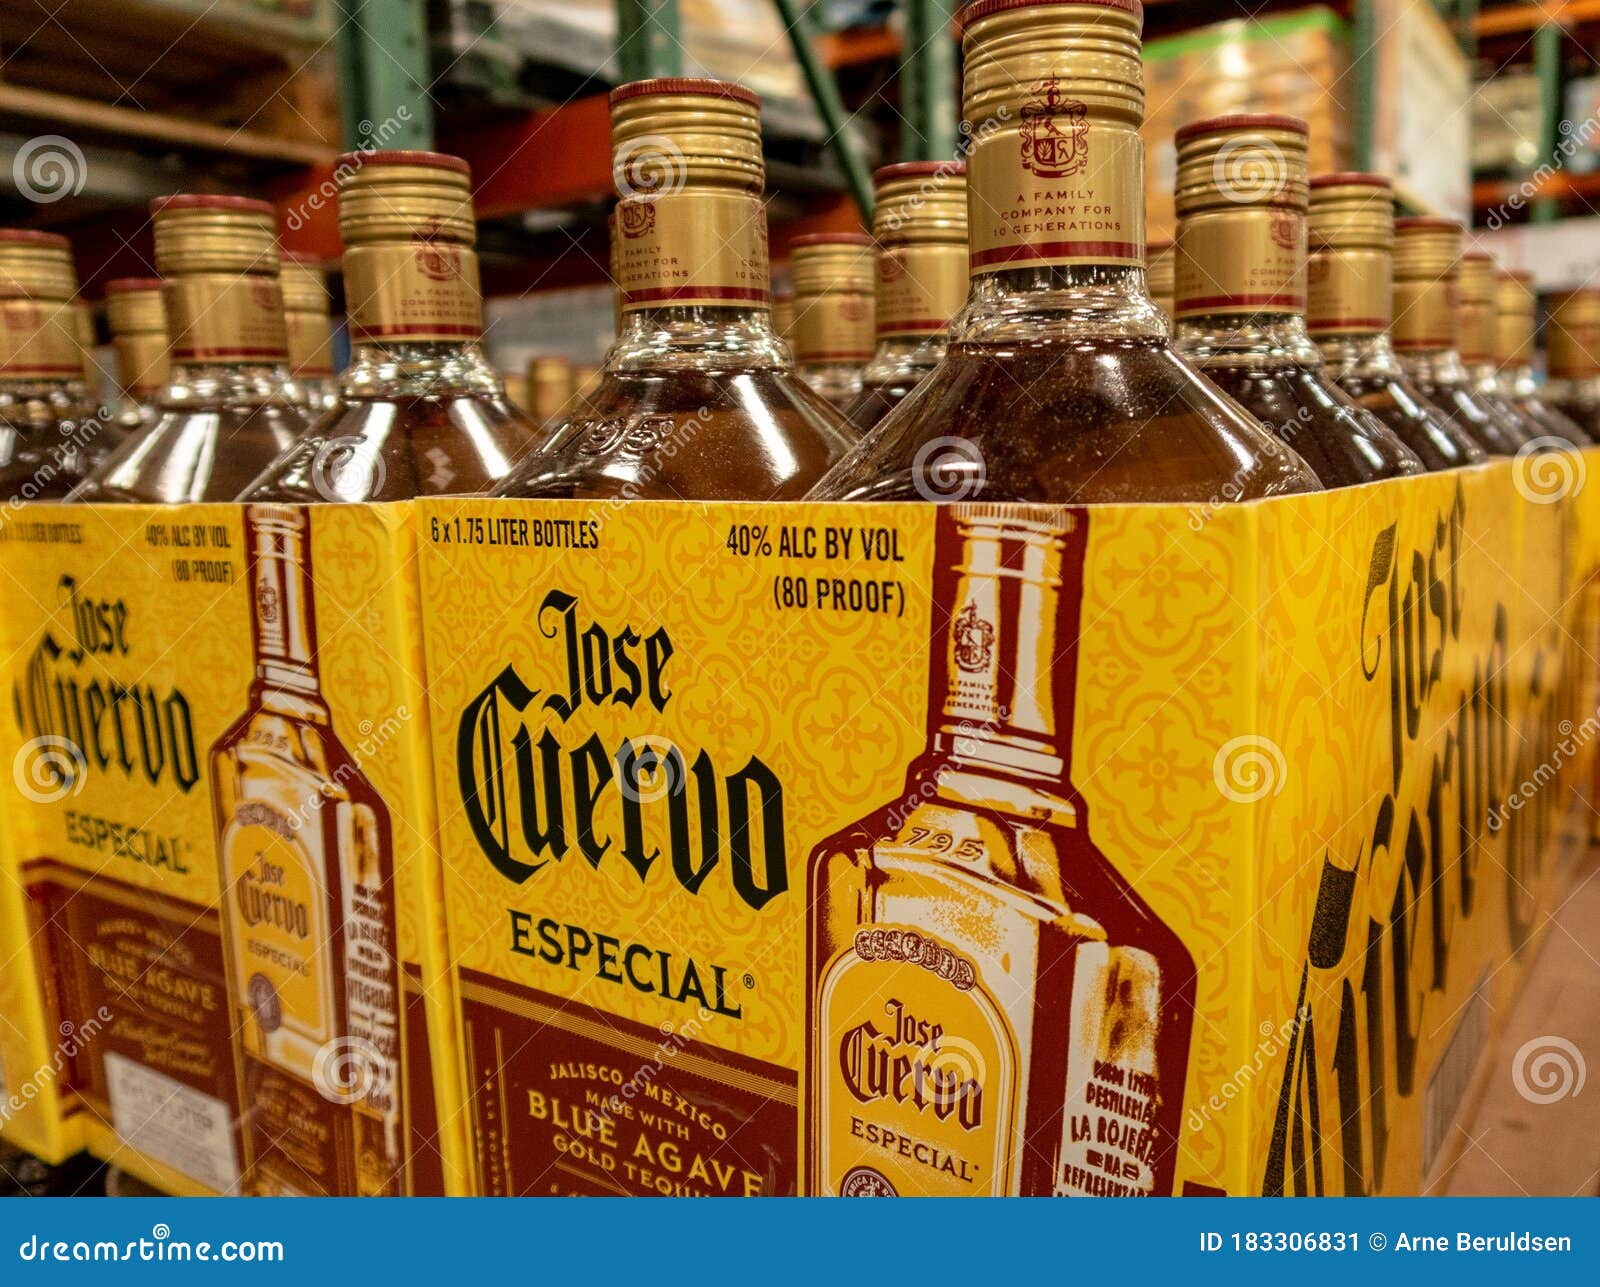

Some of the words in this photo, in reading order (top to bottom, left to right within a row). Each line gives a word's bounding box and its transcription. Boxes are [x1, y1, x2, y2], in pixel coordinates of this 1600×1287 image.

[1001, 205, 1076, 220] COMPANY
[1084, 205, 1112, 216] FOR
[1017, 194, 1025, 203] A
[1034, 190, 1095, 201] FAMILY
[994, 228, 1006, 237] 10
[1013, 220, 1121, 234] GENERATIONS
[625, 246, 661, 258] FAMILY
[653, 257, 679, 266] FOR
[431, 516, 440, 543] 6
[454, 516, 485, 545] 1.75
[488, 517, 529, 547] LITER
[533, 519, 600, 550] BOTTLES
[726, 523, 772, 558] 40%
[779, 526, 818, 560] ALC
[826, 526, 855, 561] BY
[861, 527, 905, 562] VOL
[773, 575, 808, 611] (80
[817, 578, 906, 620] PROOF)
[57, 573, 130, 668] Jose
[537, 589, 675, 725] Jose
[958, 680, 994, 691] FAMILY
[12, 630, 200, 794] Cuervo
[457, 662, 790, 912] Cuervo
[64, 811, 190, 874] ESPECIAL
[902, 827, 985, 861] 795
[884, 998, 944, 1054] Jose
[839, 1020, 983, 1131] Cuervo
[527, 1088, 618, 1149] BLUE
[550, 1062, 623, 1086] JALISCO
[644, 1080, 727, 1141] MEXICO
[586, 1090, 635, 1121] MADE
[640, 1109, 690, 1142] WITH
[1070, 1114, 1092, 1143] LA
[553, 1133, 616, 1172] GOLD
